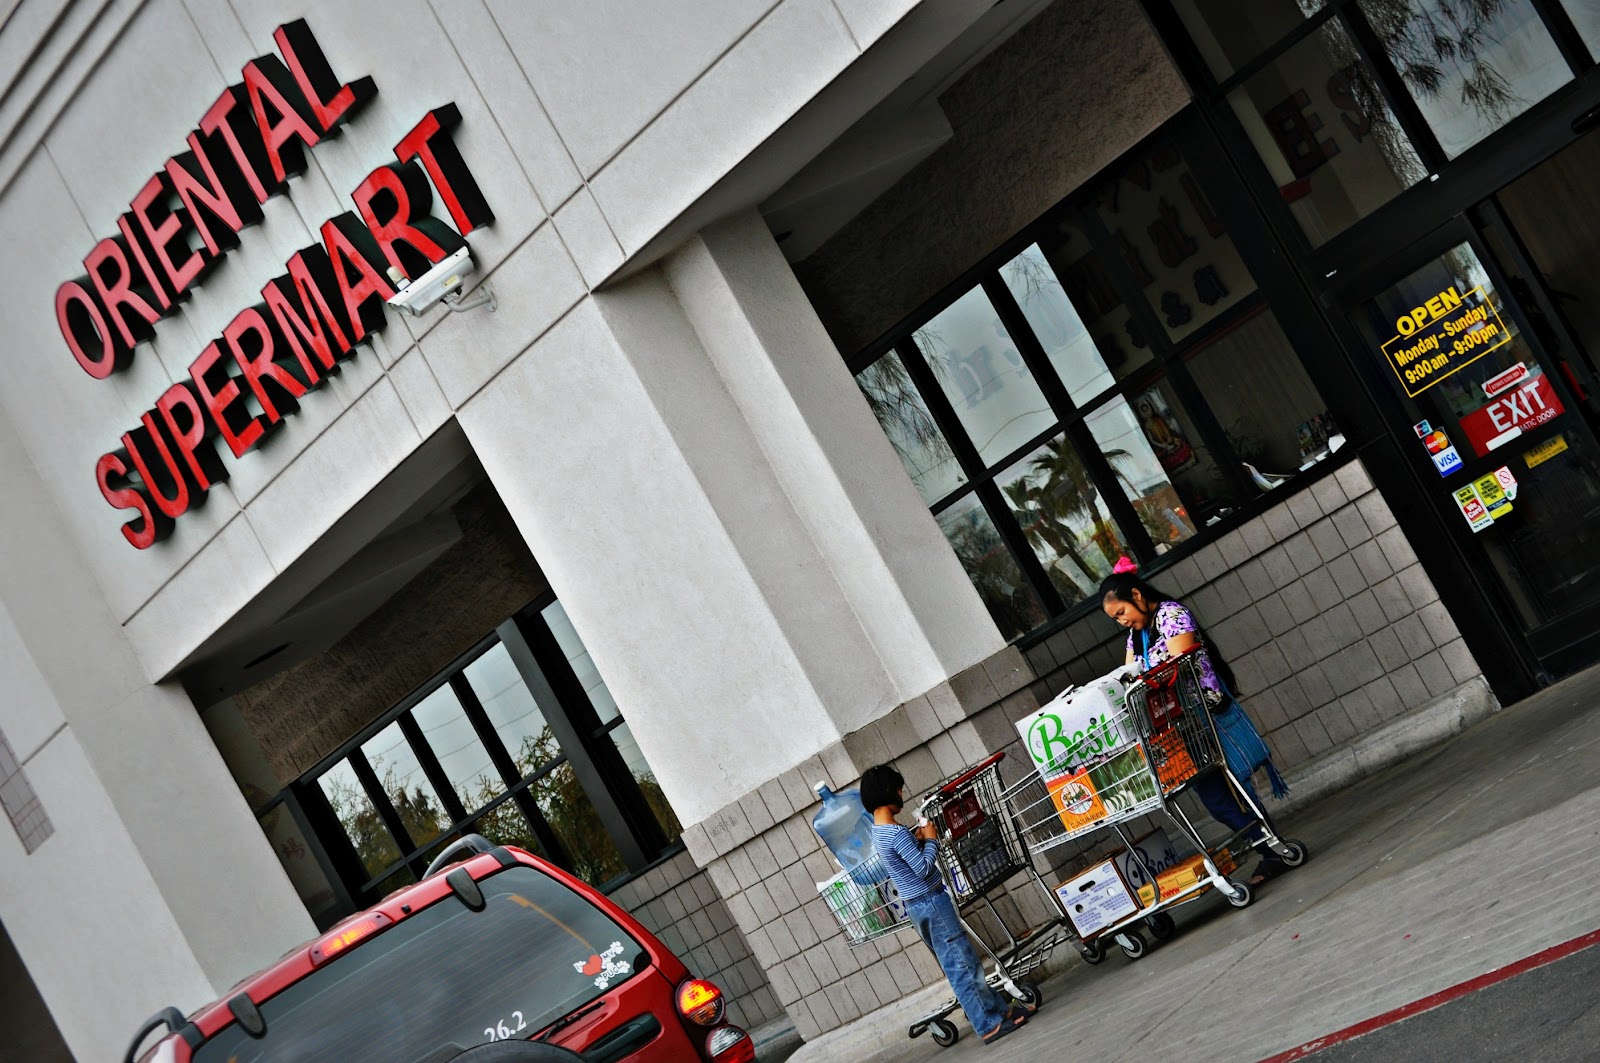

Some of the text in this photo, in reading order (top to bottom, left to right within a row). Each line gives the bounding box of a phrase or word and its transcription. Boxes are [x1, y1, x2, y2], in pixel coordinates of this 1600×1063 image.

[55, 22, 366, 380] ORIENTAL
[96, 106, 486, 549] SUPERMART
[1394, 331, 1440, 367] Monday
[1443, 304, 1489, 335] Sunday
[1396, 286, 1462, 336] OPEN
[1453, 322, 1499, 355] 9:00pm
[1486, 380, 1548, 433] EXIT
[1536, 407, 1556, 424] DOOR
[1438, 452, 1458, 468] VISA
[1028, 713, 1119, 772] Best
[601, 949, 614, 959] MY
[484, 1010, 527, 1042] 26.2
